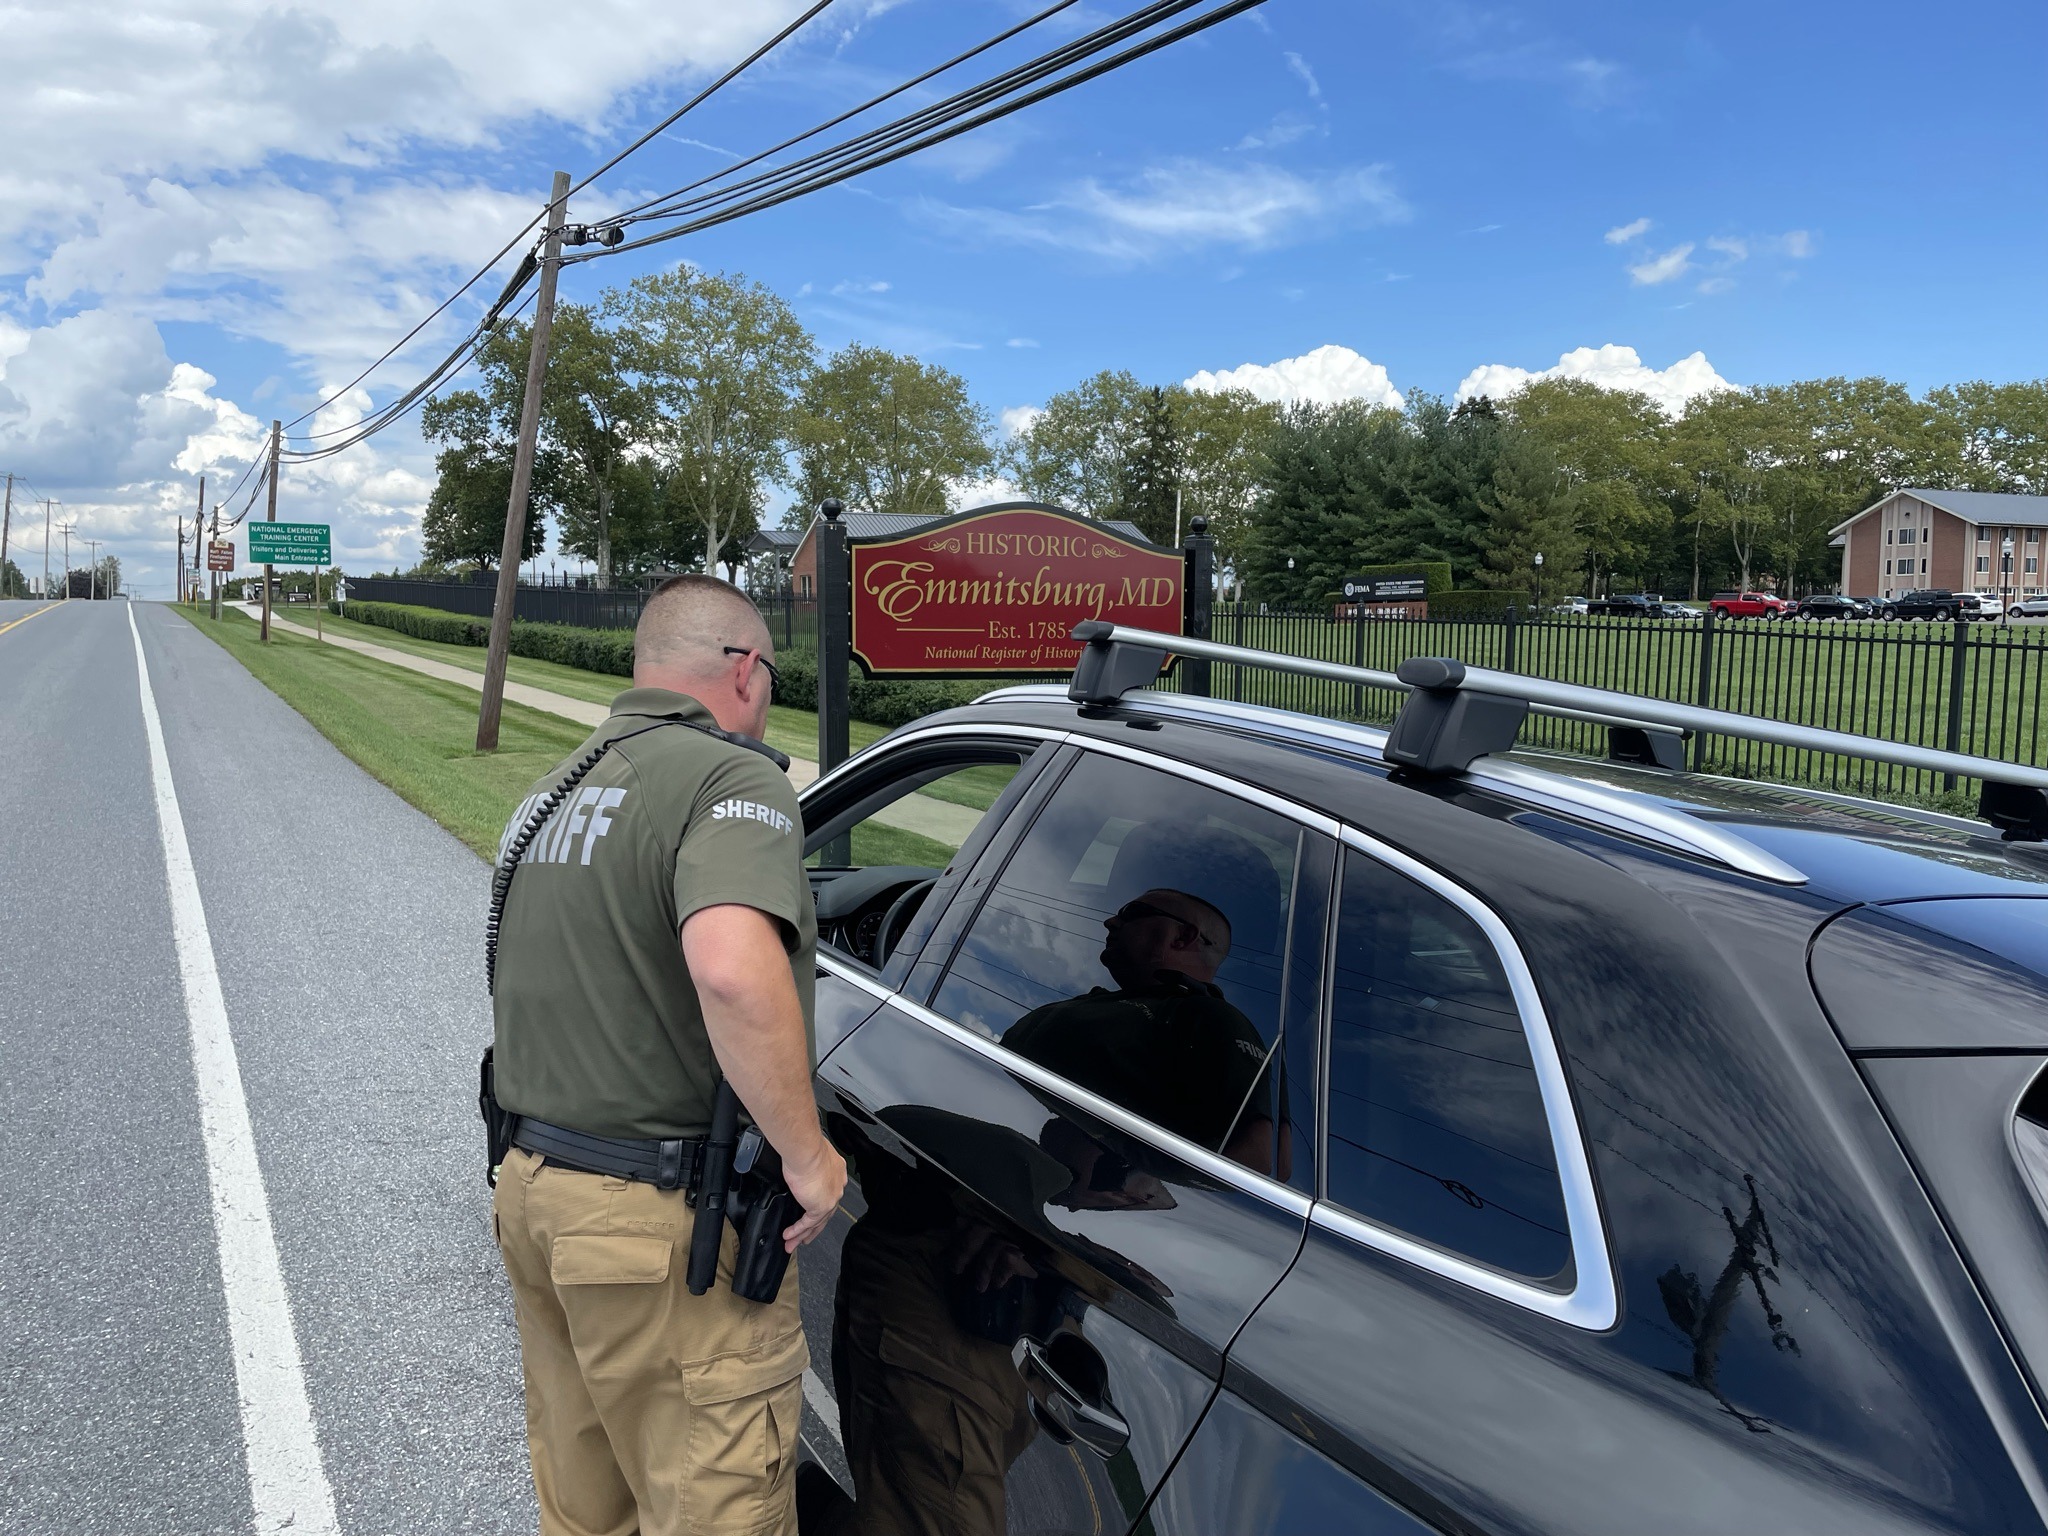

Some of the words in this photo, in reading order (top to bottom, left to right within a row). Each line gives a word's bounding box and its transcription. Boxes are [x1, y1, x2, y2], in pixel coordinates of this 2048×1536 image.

[251, 526, 285, 534] NATIONAL
[287, 527, 328, 535] EMERGENCY
[251, 545, 273, 553] Visitors
[966, 532, 1087, 558] HISTORIC
[291, 554, 318, 562] Entrance
[863, 560, 1114, 622] Emmitsburg,
[1115, 576, 1175, 608] MD
[1354, 585, 1370, 593] FEMA
[988, 621, 1021, 639] Est.
[1028, 622, 1066, 639] 1785
[924, 644, 980, 659] National
[981, 646, 1028, 664] Register
[1030, 644, 1043, 664] of
[1044, 646, 1083, 659] Histori
[712, 799, 794, 836] SHERIFF
